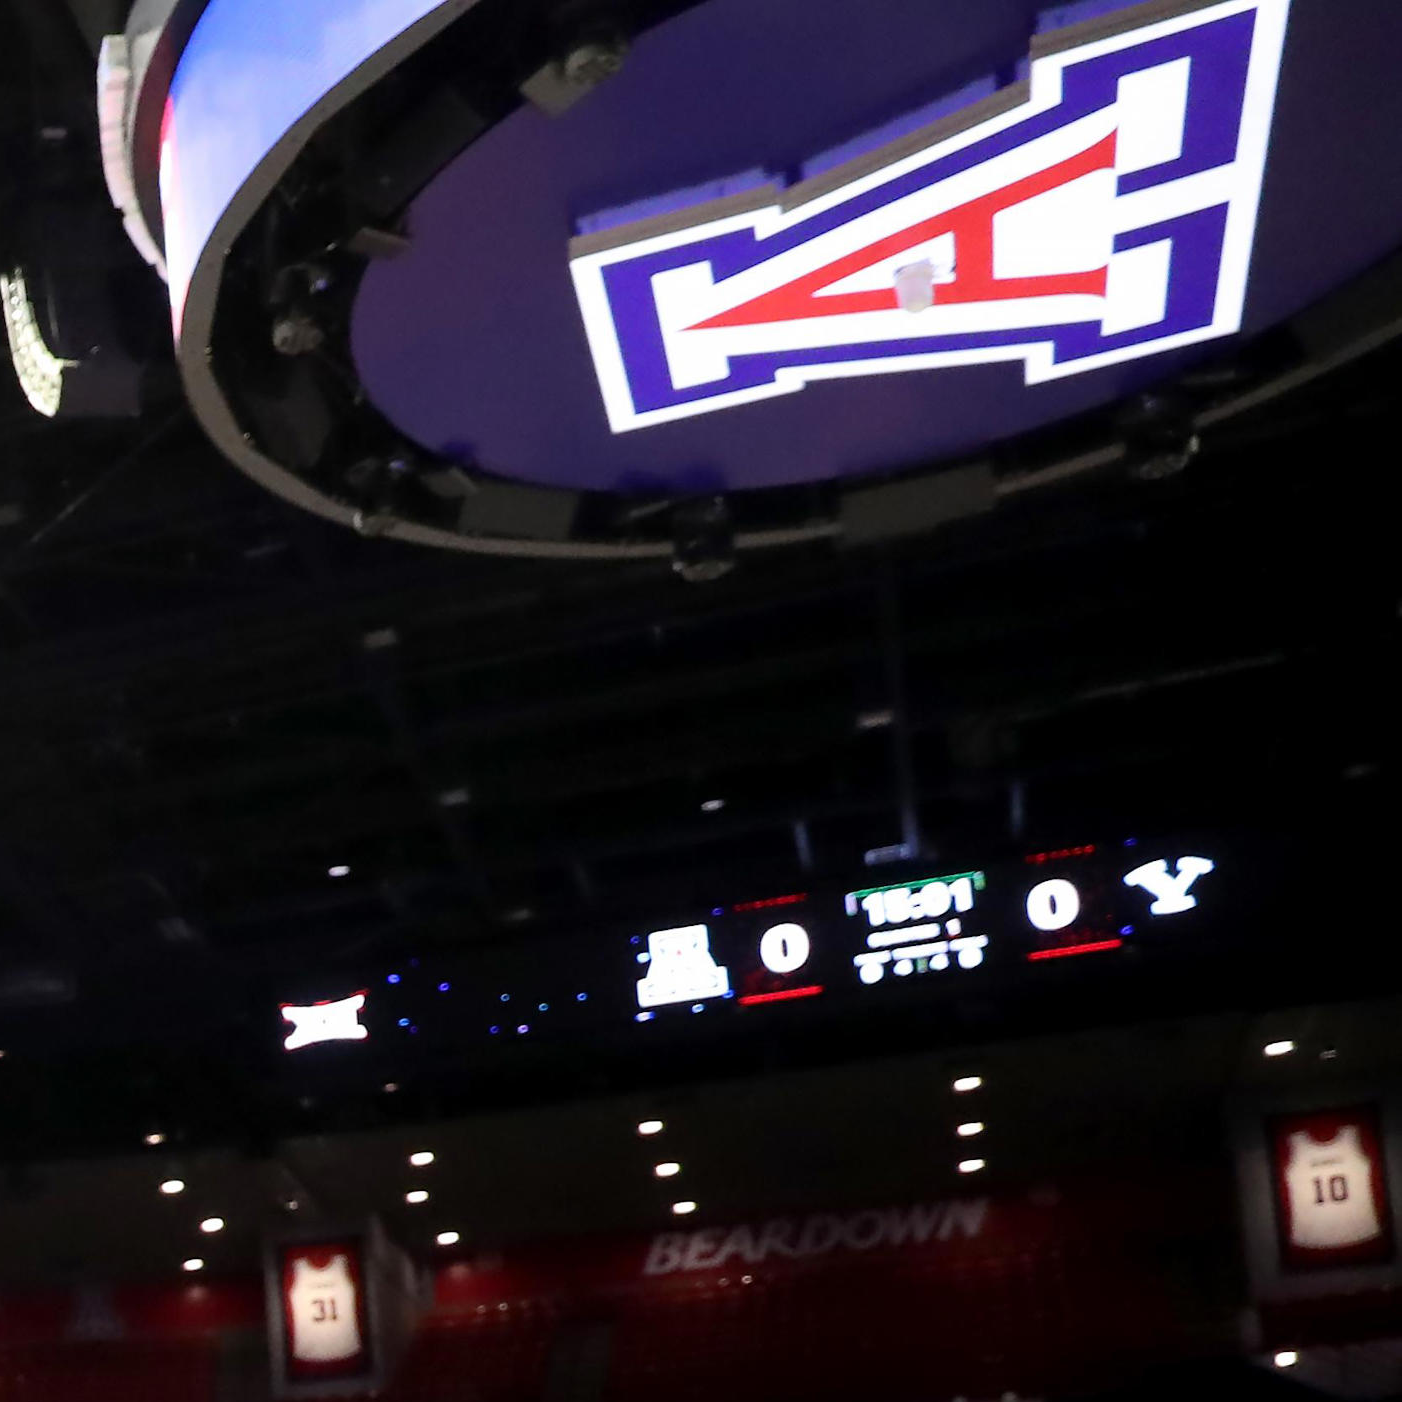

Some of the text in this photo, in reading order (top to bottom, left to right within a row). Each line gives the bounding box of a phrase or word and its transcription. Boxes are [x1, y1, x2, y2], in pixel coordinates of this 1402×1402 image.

[1026, 878, 1080, 931] 0
[759, 922, 810, 974] 0
[1312, 1173, 1349, 1206] 10
[310, 1298, 338, 1323] 31
